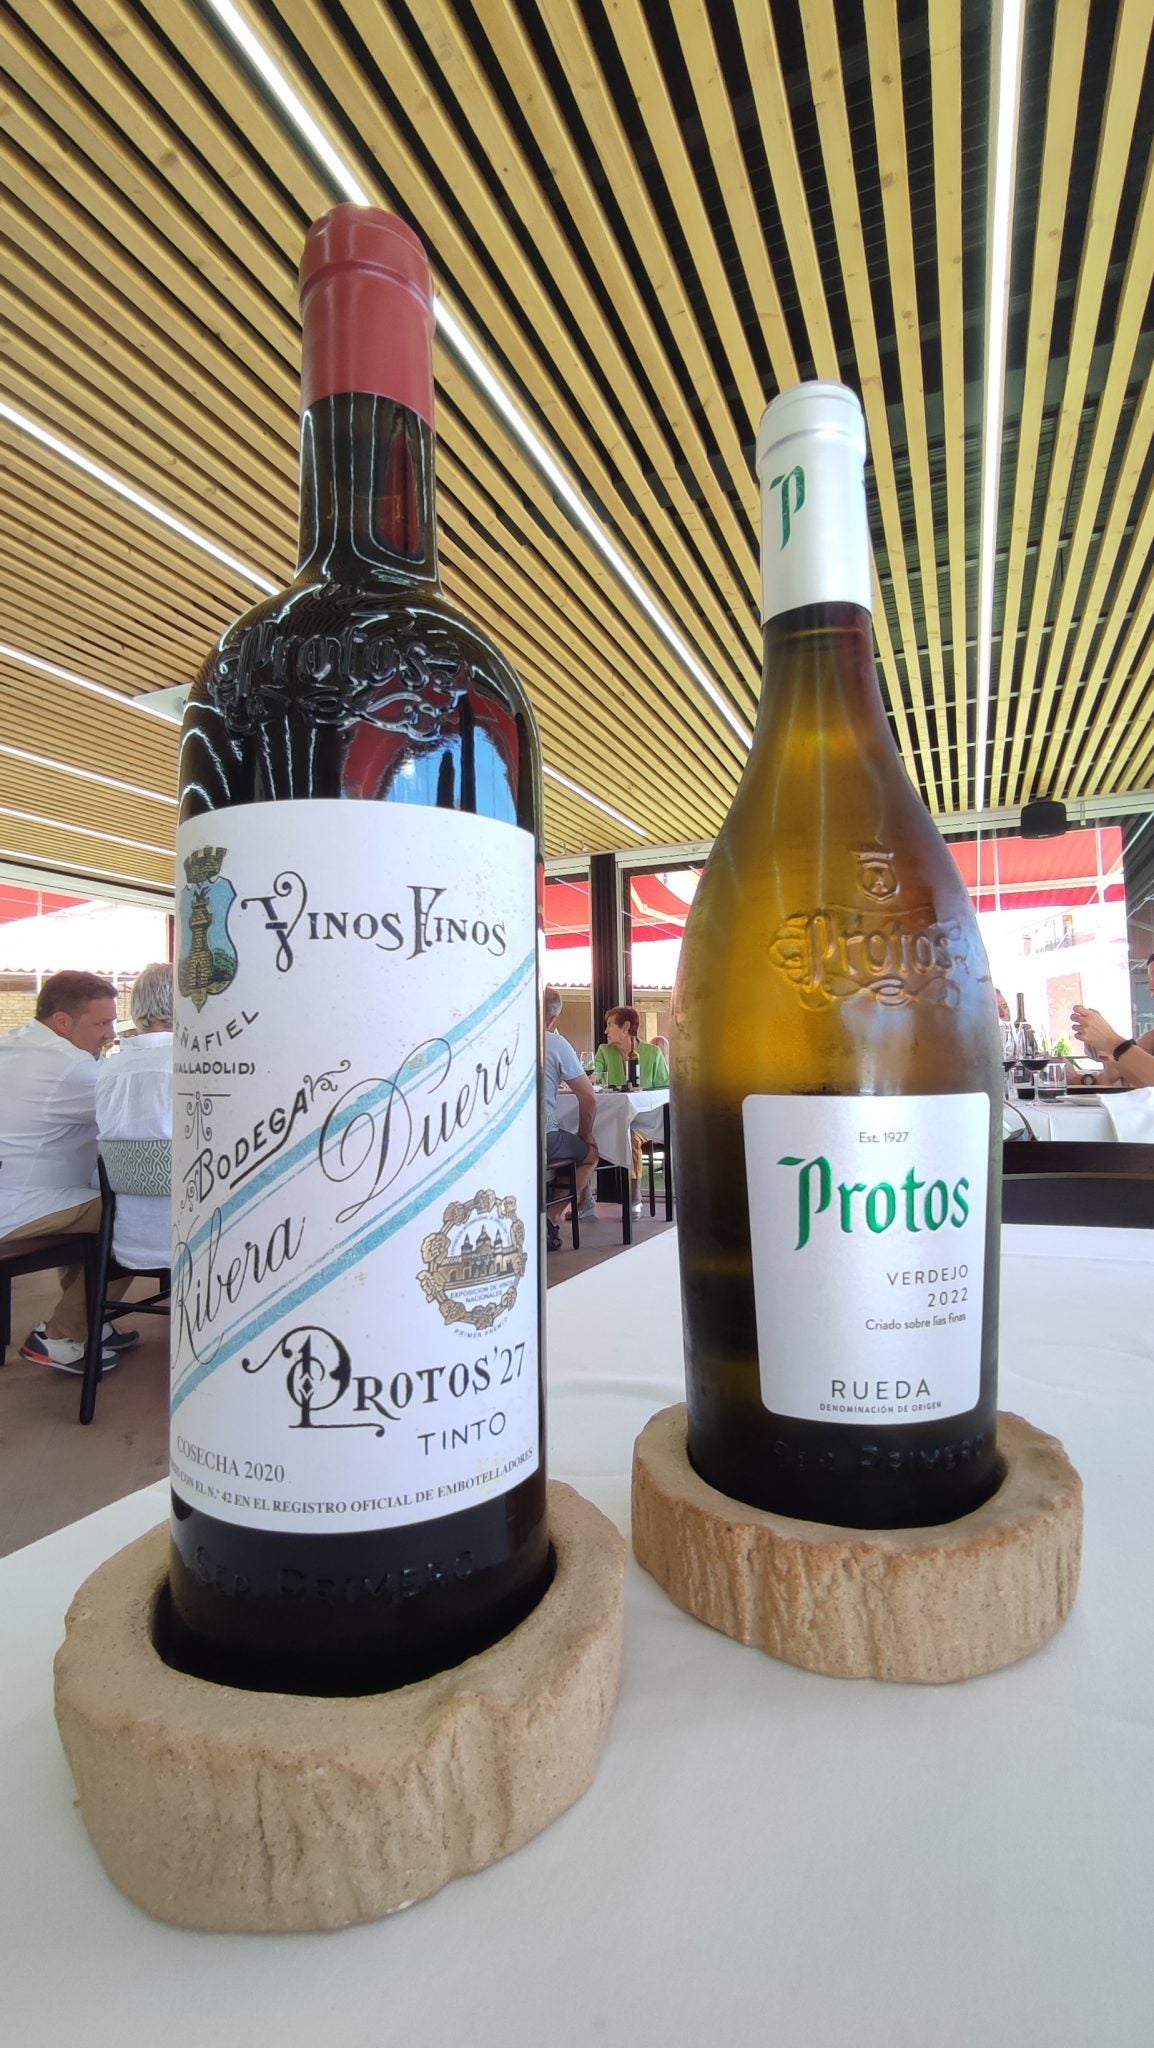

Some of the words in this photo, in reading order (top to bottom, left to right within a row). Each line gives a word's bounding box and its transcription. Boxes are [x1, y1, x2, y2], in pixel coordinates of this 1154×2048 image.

[769, 465, 806, 551] P
[183, 1087, 309, 1204] BODEGA
[319, 1023, 520, 1223] Duero
[883, 1131, 910, 1143] 1927
[776, 1156, 970, 1251] Protos
[886, 1264, 969, 1286] VERDEJO
[927, 1287, 968, 1307] 2022
[865, 1318, 902, 1330] Criado
[904, 1317, 931, 1329] sobre
[819, 1402, 894, 1414] DENOMINACIÓN
[898, 1405, 908, 1413] DE
[911, 1401, 942, 1412] ORIGEN
[831, 1379, 931, 1400] RUEDA
[417, 1411, 506, 1456] TINTO
[177, 1435, 240, 1477] COSECHA
[244, 1461, 285, 1483] 2020
[195, 1480, 206, 1495] EL
[221, 1491, 232, 1504] 42
[235, 1494, 250, 1507] EN
[253, 1498, 270, 1511] EL
[273, 1500, 347, 1514] REGISTRO
[350, 1496, 413, 1512] OFICIAL
[415, 1489, 434, 1504] DE
[437, 1448, 533, 1498] EMBOTELLADORES
